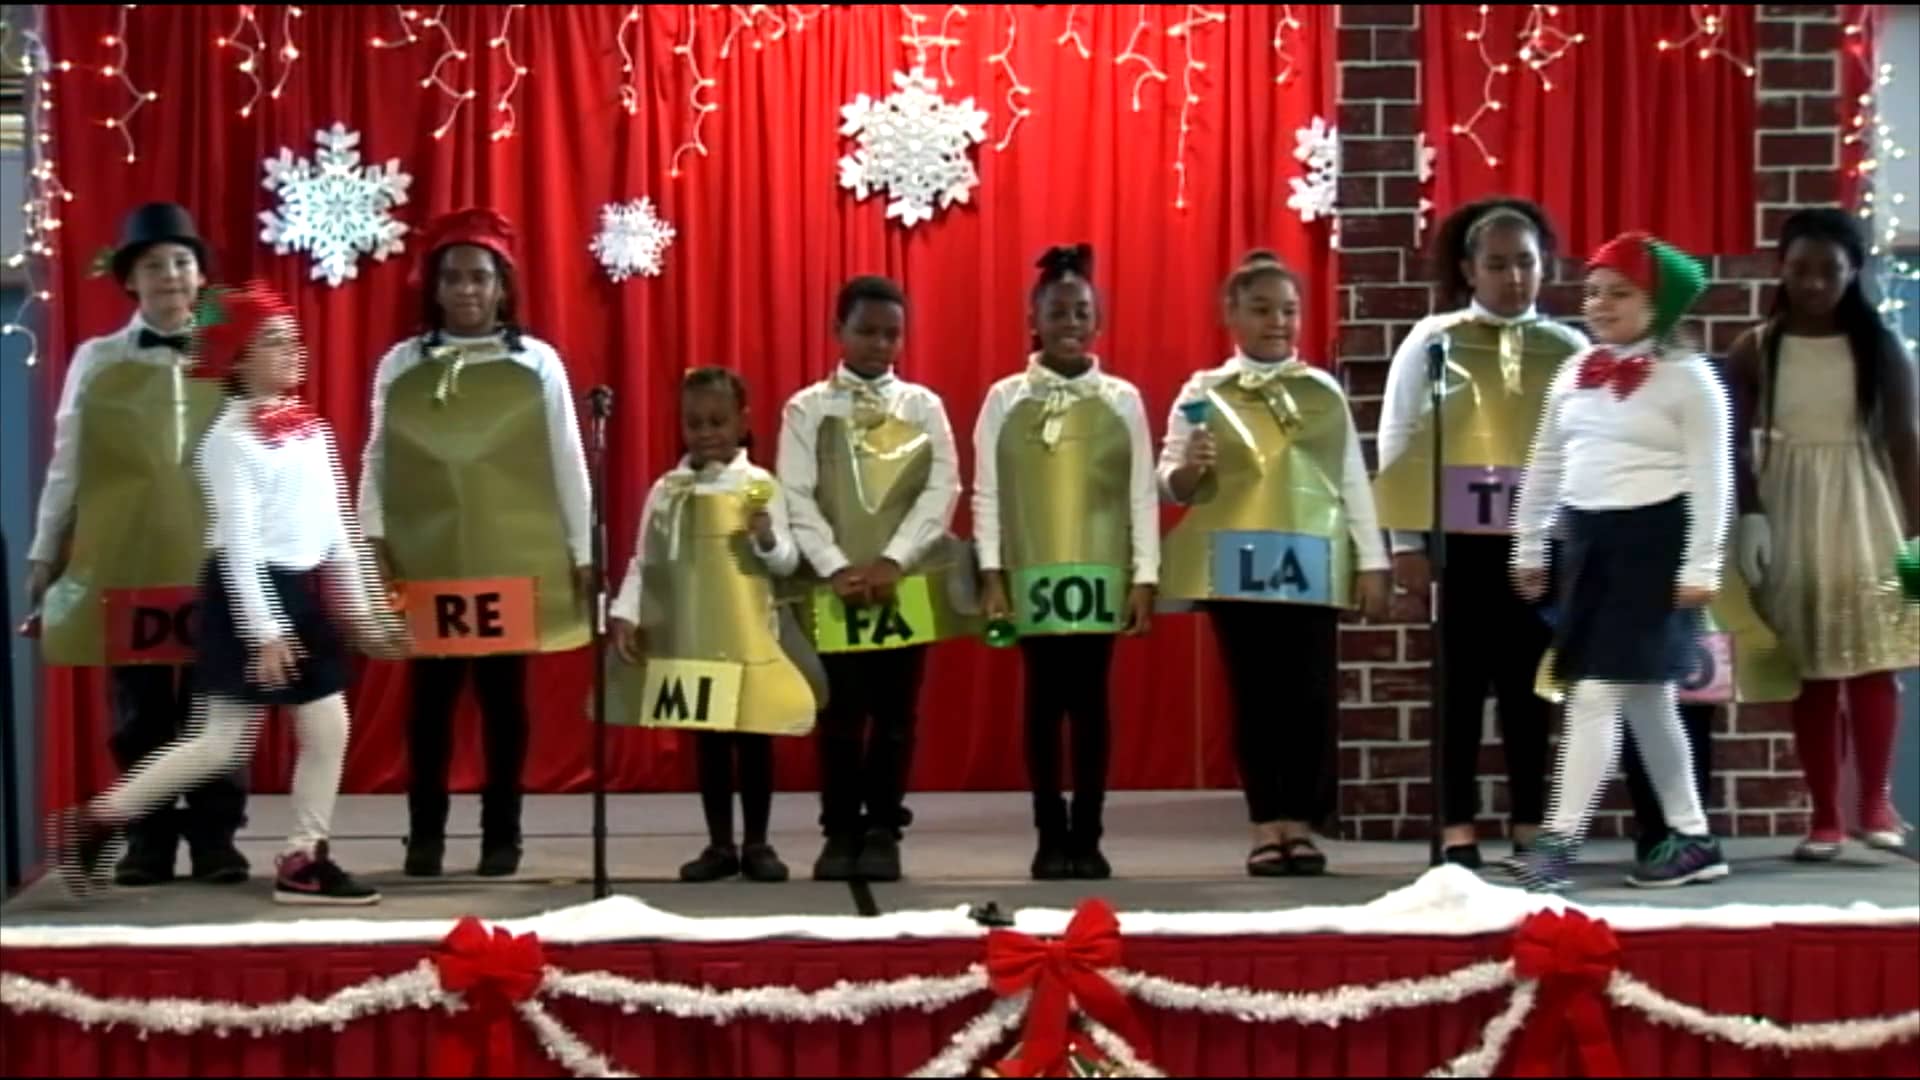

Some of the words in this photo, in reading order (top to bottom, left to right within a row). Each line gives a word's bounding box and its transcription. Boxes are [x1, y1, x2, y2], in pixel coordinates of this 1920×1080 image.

[1239, 545, 1310, 593] LA
[435, 593, 504, 639] RE
[845, 598, 914, 645] FA
[1028, 575, 1114, 623] SOL
[652, 675, 713, 722] MI
